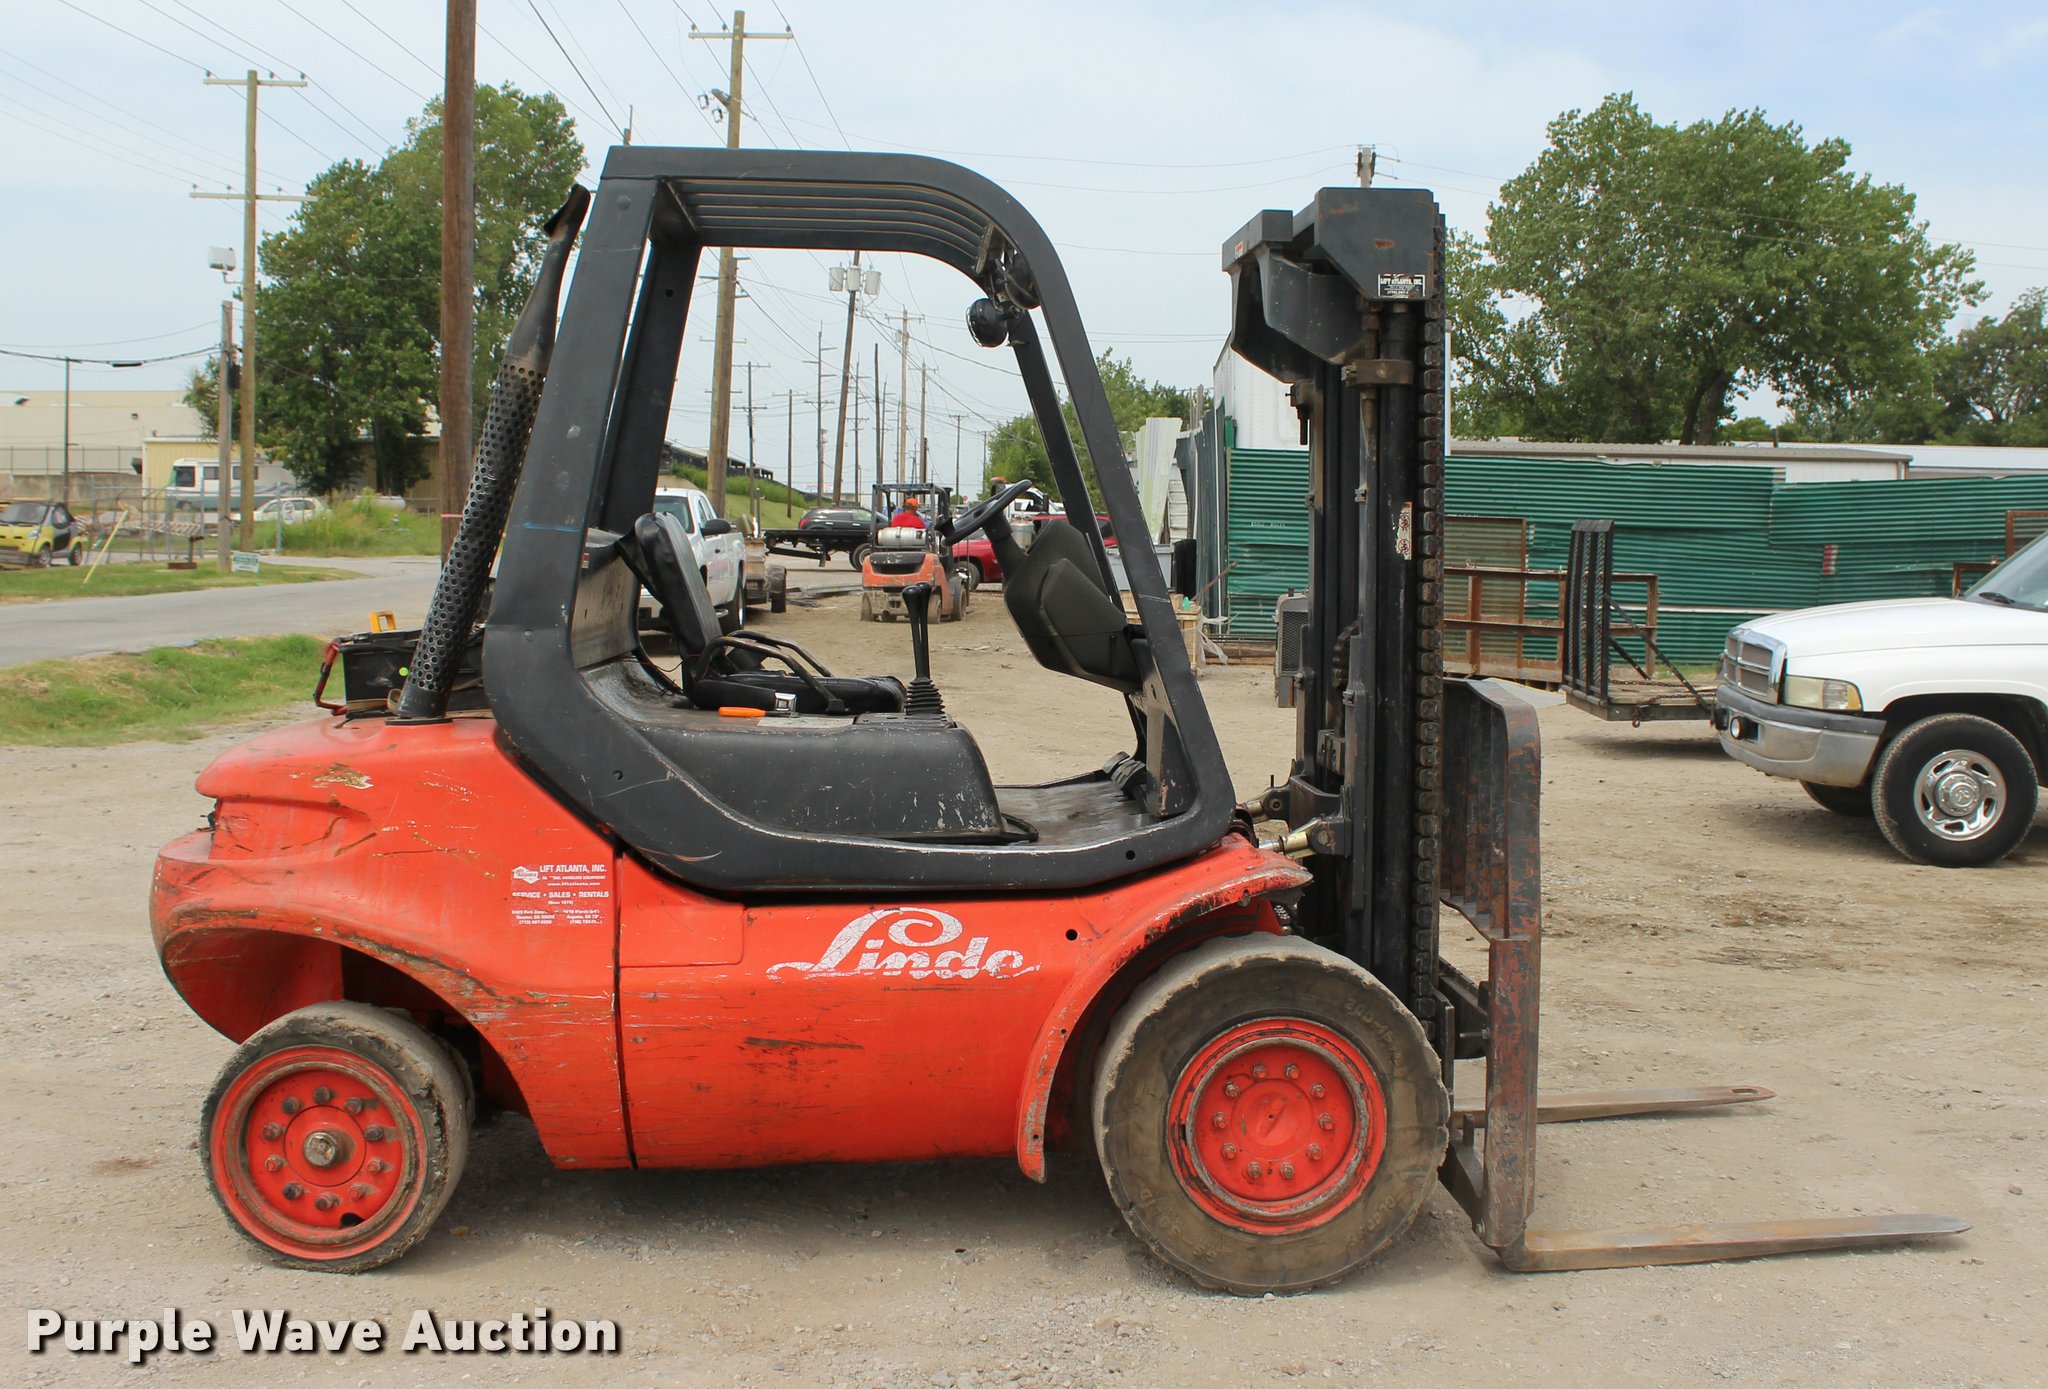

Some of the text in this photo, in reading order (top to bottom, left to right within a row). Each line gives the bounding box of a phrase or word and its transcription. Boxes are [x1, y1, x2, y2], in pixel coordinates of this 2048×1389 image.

[540, 864, 607, 874] LIFT ATLANTA, INC.
[549, 891, 571, 899] SALES
[578, 891, 609, 899] RENTALS
[765, 906, 1042, 985] Linde
